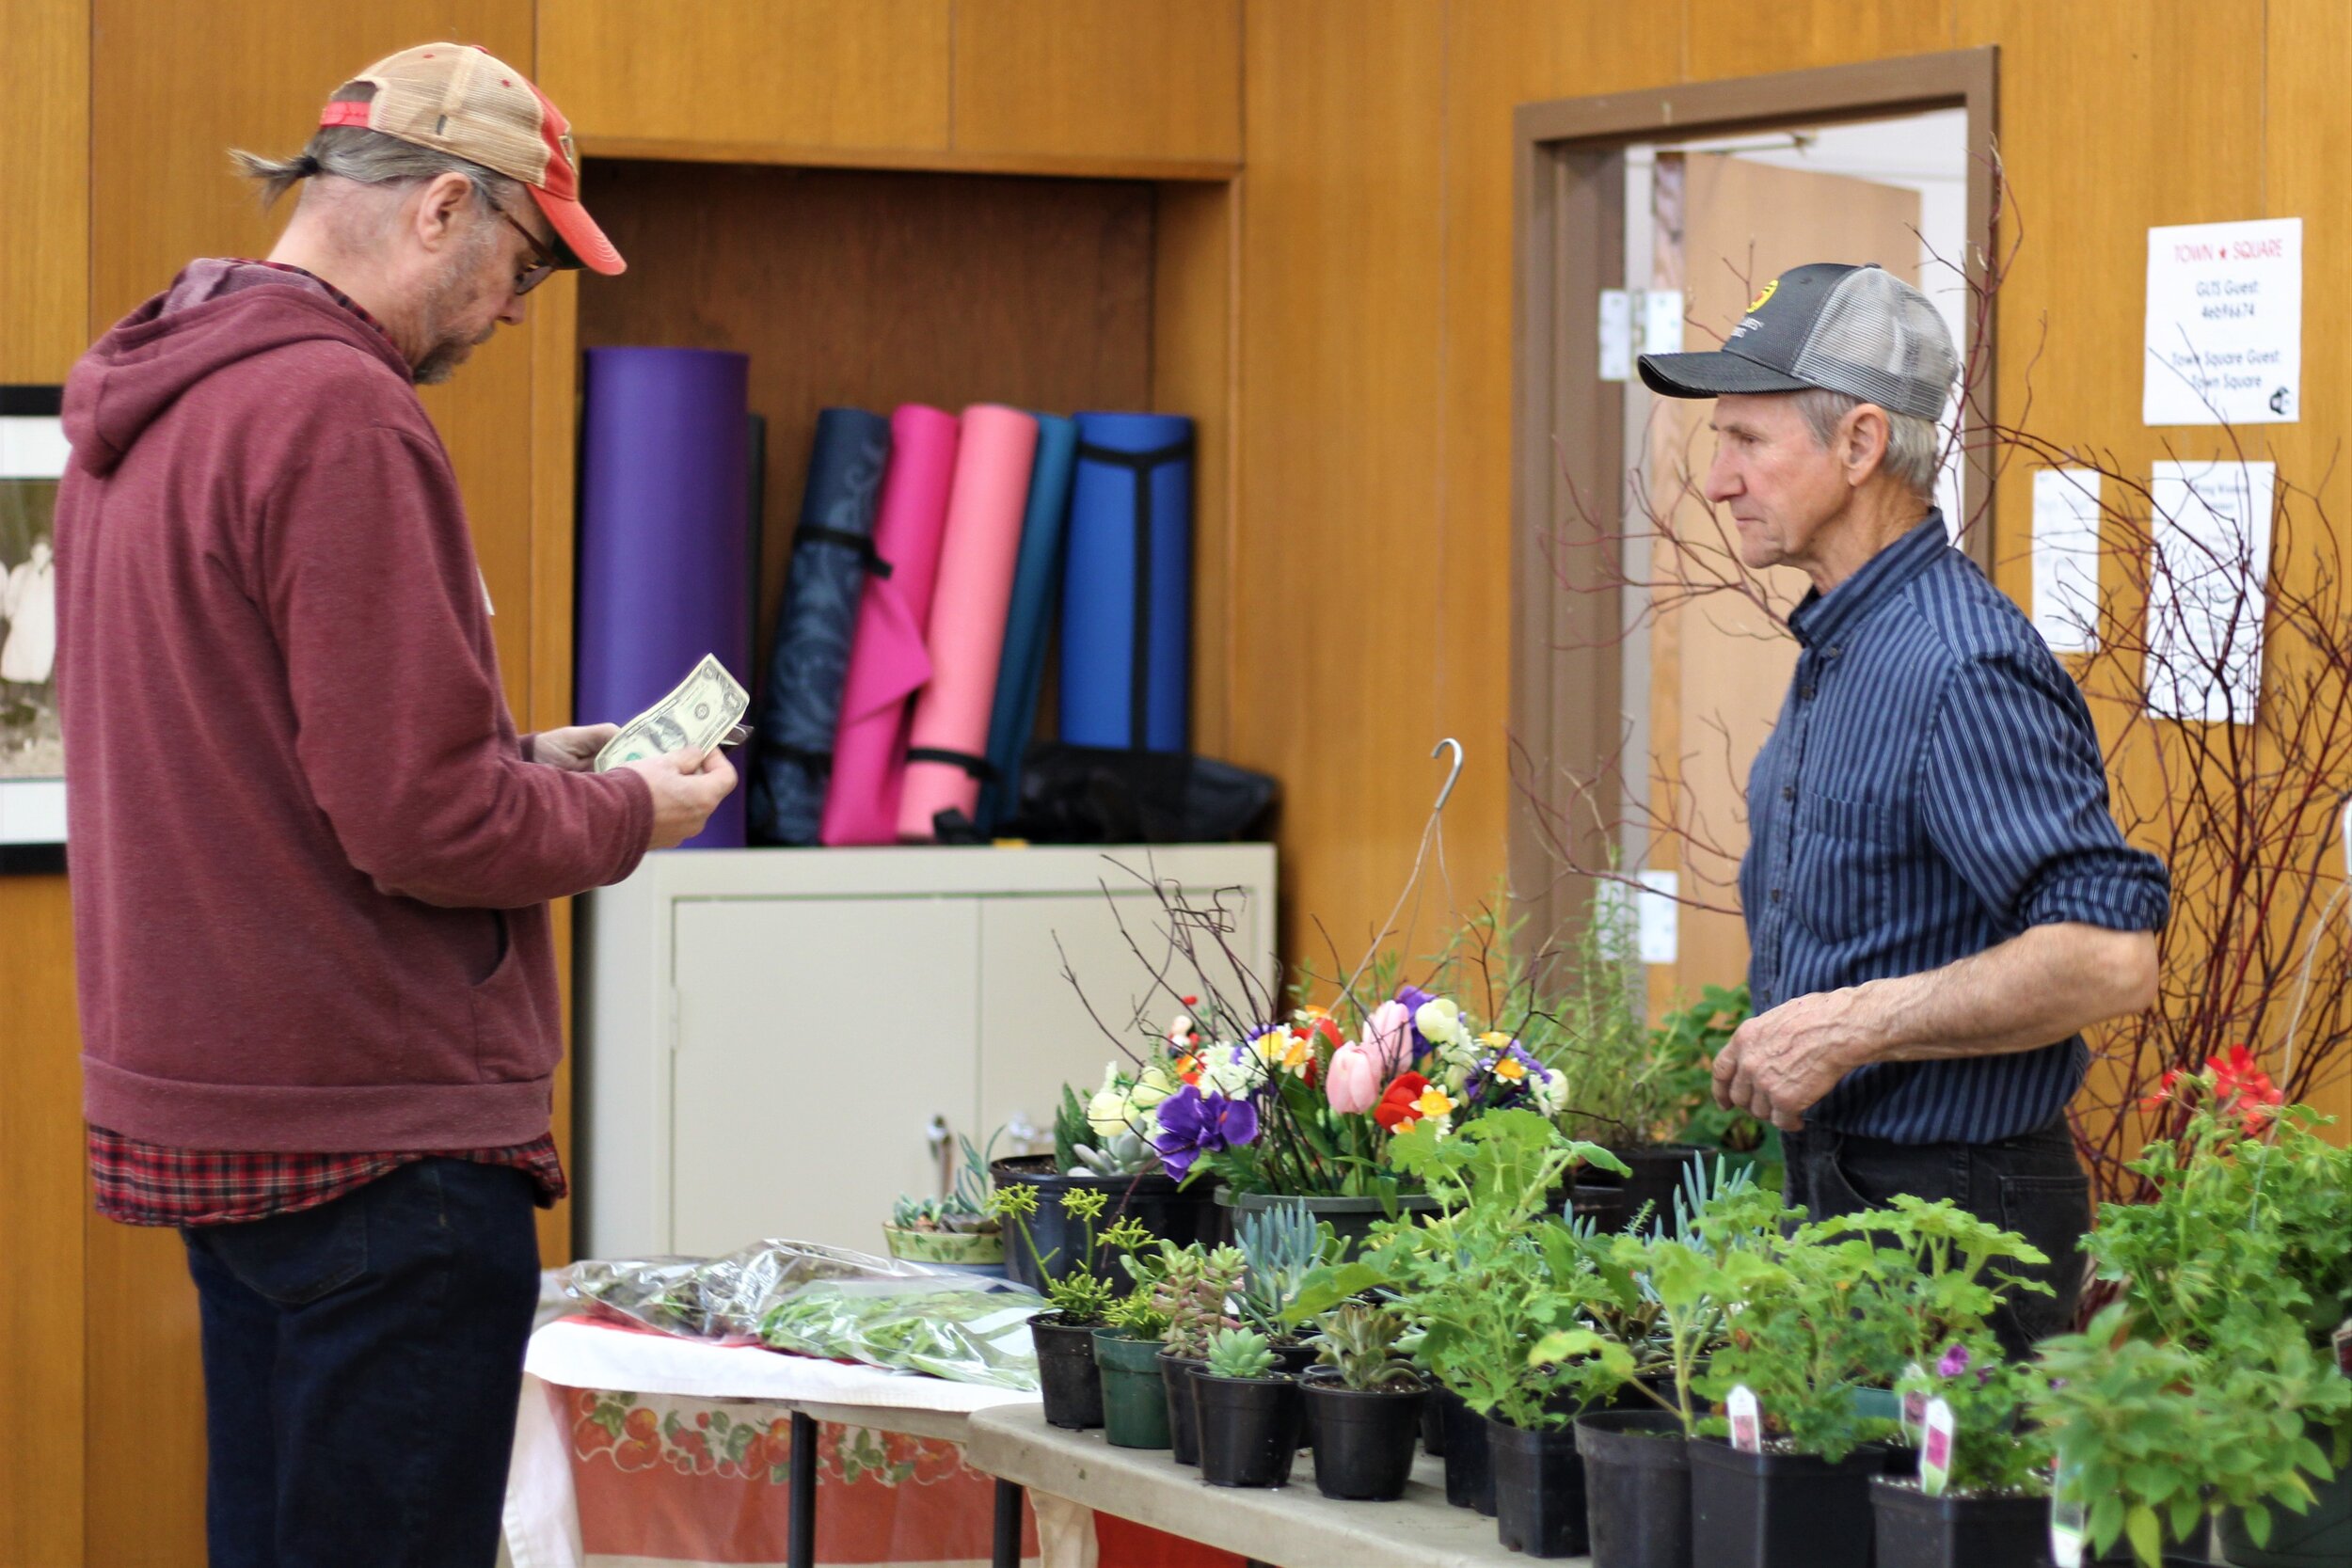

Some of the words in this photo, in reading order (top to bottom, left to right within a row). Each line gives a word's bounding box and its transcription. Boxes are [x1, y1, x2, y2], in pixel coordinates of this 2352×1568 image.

[2174, 244, 2213, 262] TOWN
[2233, 239, 2282, 260] SQUARE
[2224, 278, 2259, 295] Guest
[2204, 350, 2243, 368] Square
[2247, 348, 2280, 365] Guest
[2223, 372, 2262, 390] Square
